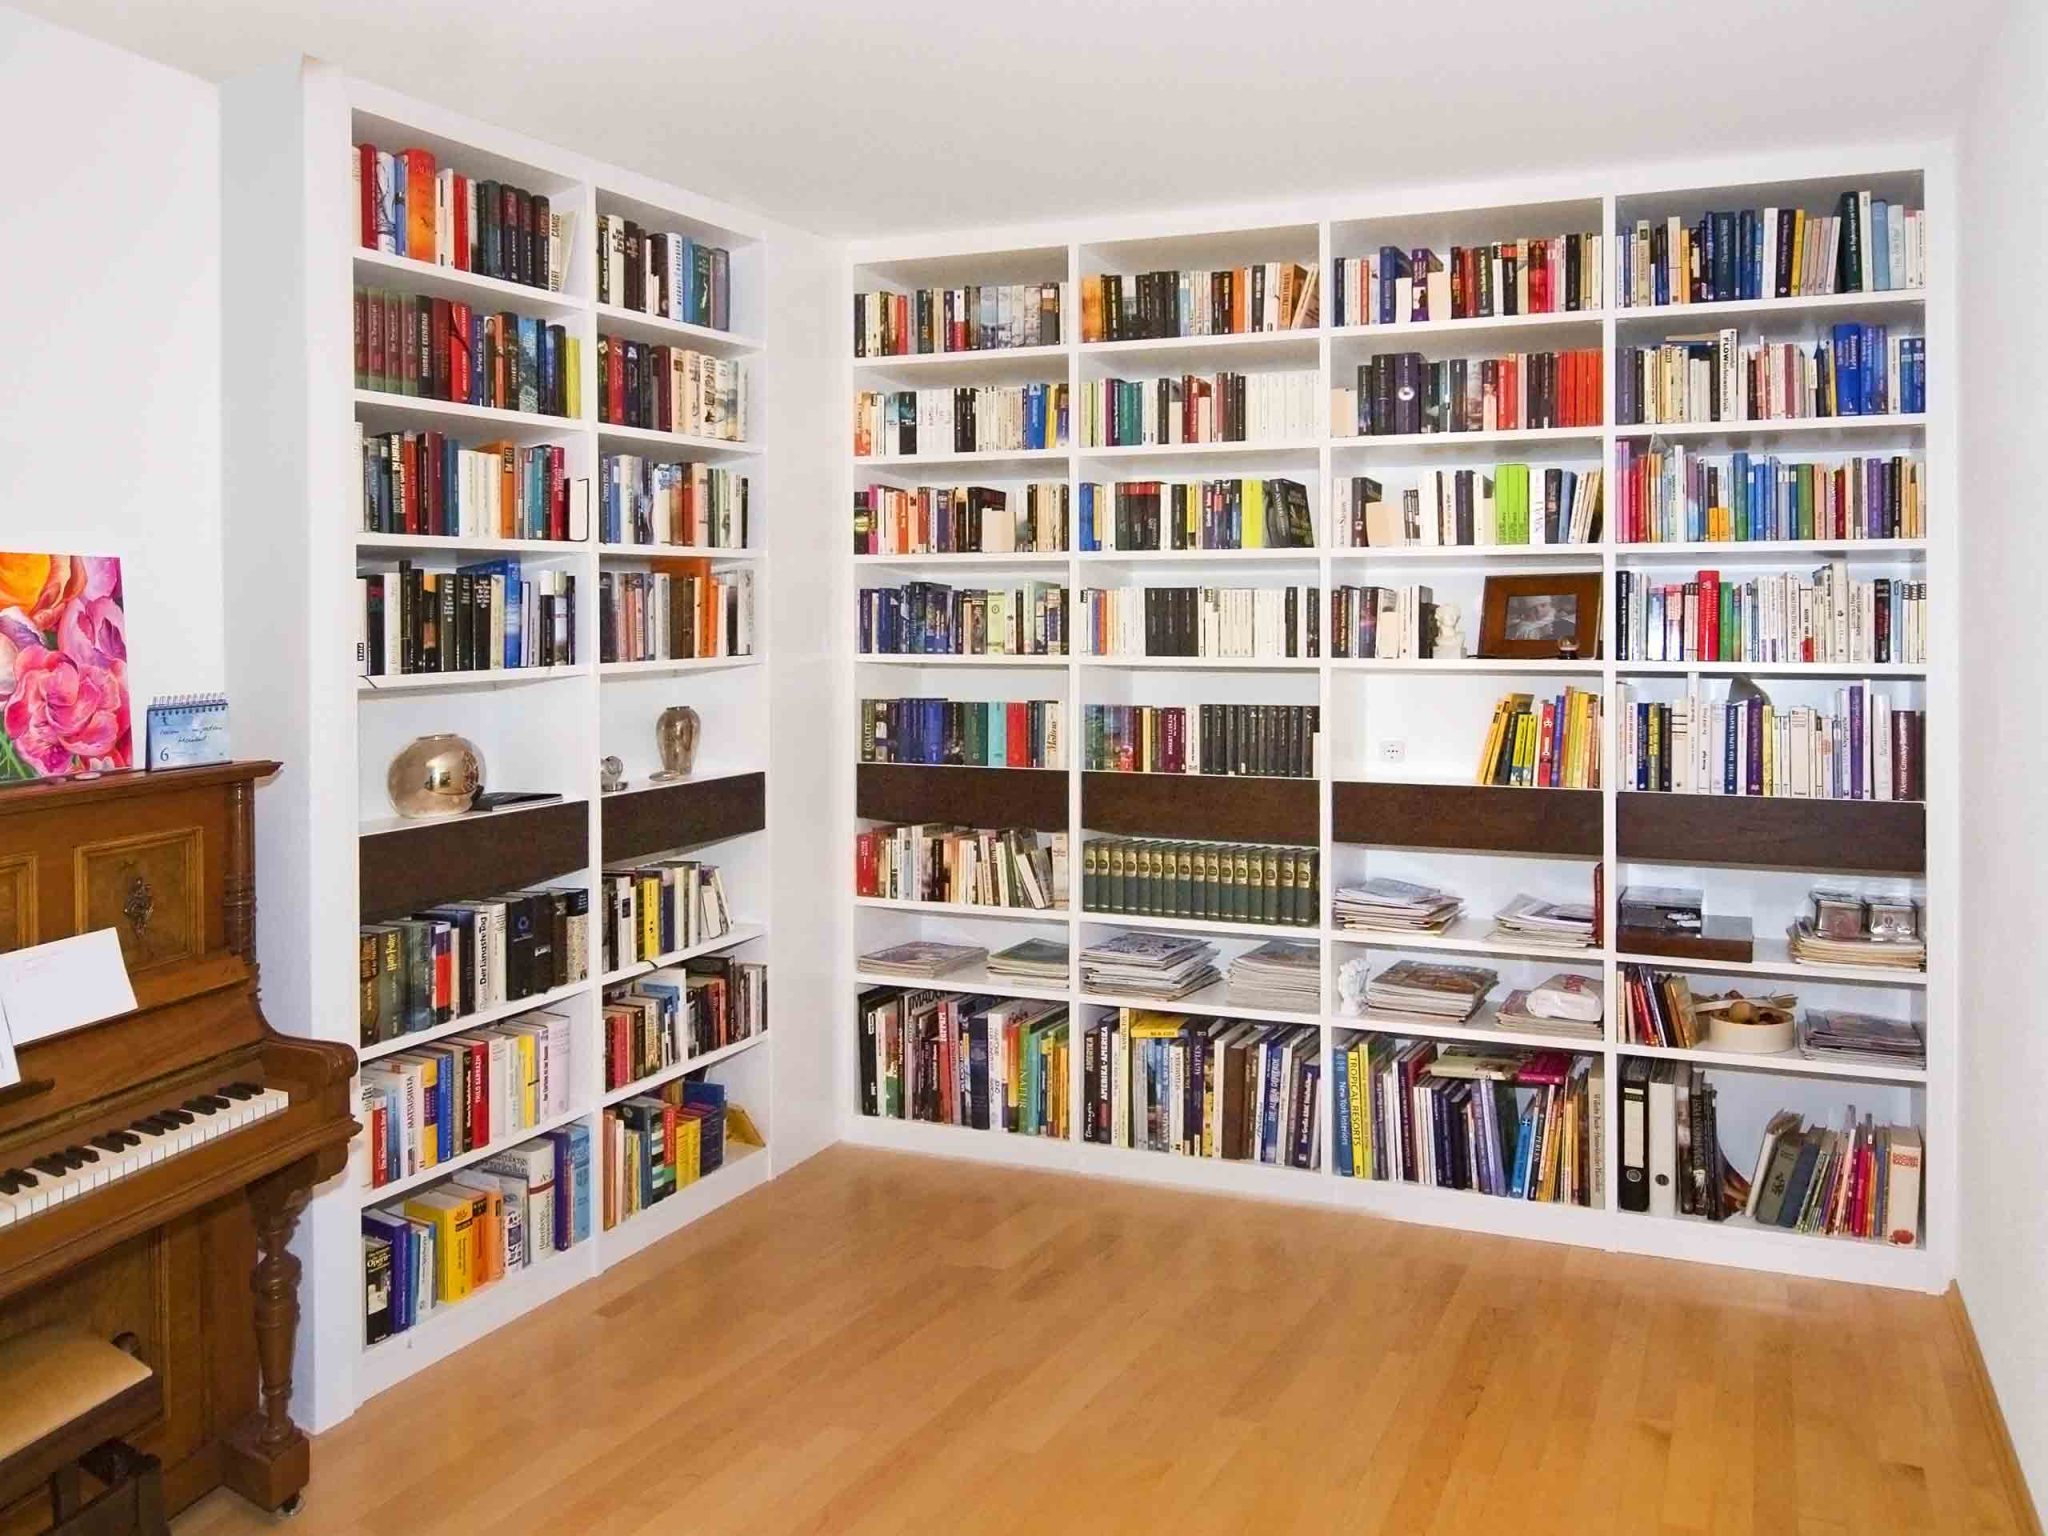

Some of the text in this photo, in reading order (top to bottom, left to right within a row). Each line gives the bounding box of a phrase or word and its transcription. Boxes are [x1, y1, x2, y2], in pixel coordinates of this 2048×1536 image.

[551, 213, 561, 238] CAMUS
[391, 434, 399, 461] ANFANG
[160, 747, 170, 762] 6
[479, 973, 487, 985] Der
[406, 1076, 416, 1129] MATSUSHITA
[1338, 1081, 1347, 1098] New
[1350, 1057, 1361, 1146] TROPICAL RESORTS
[1340, 1115, 1349, 1145] Interiors
